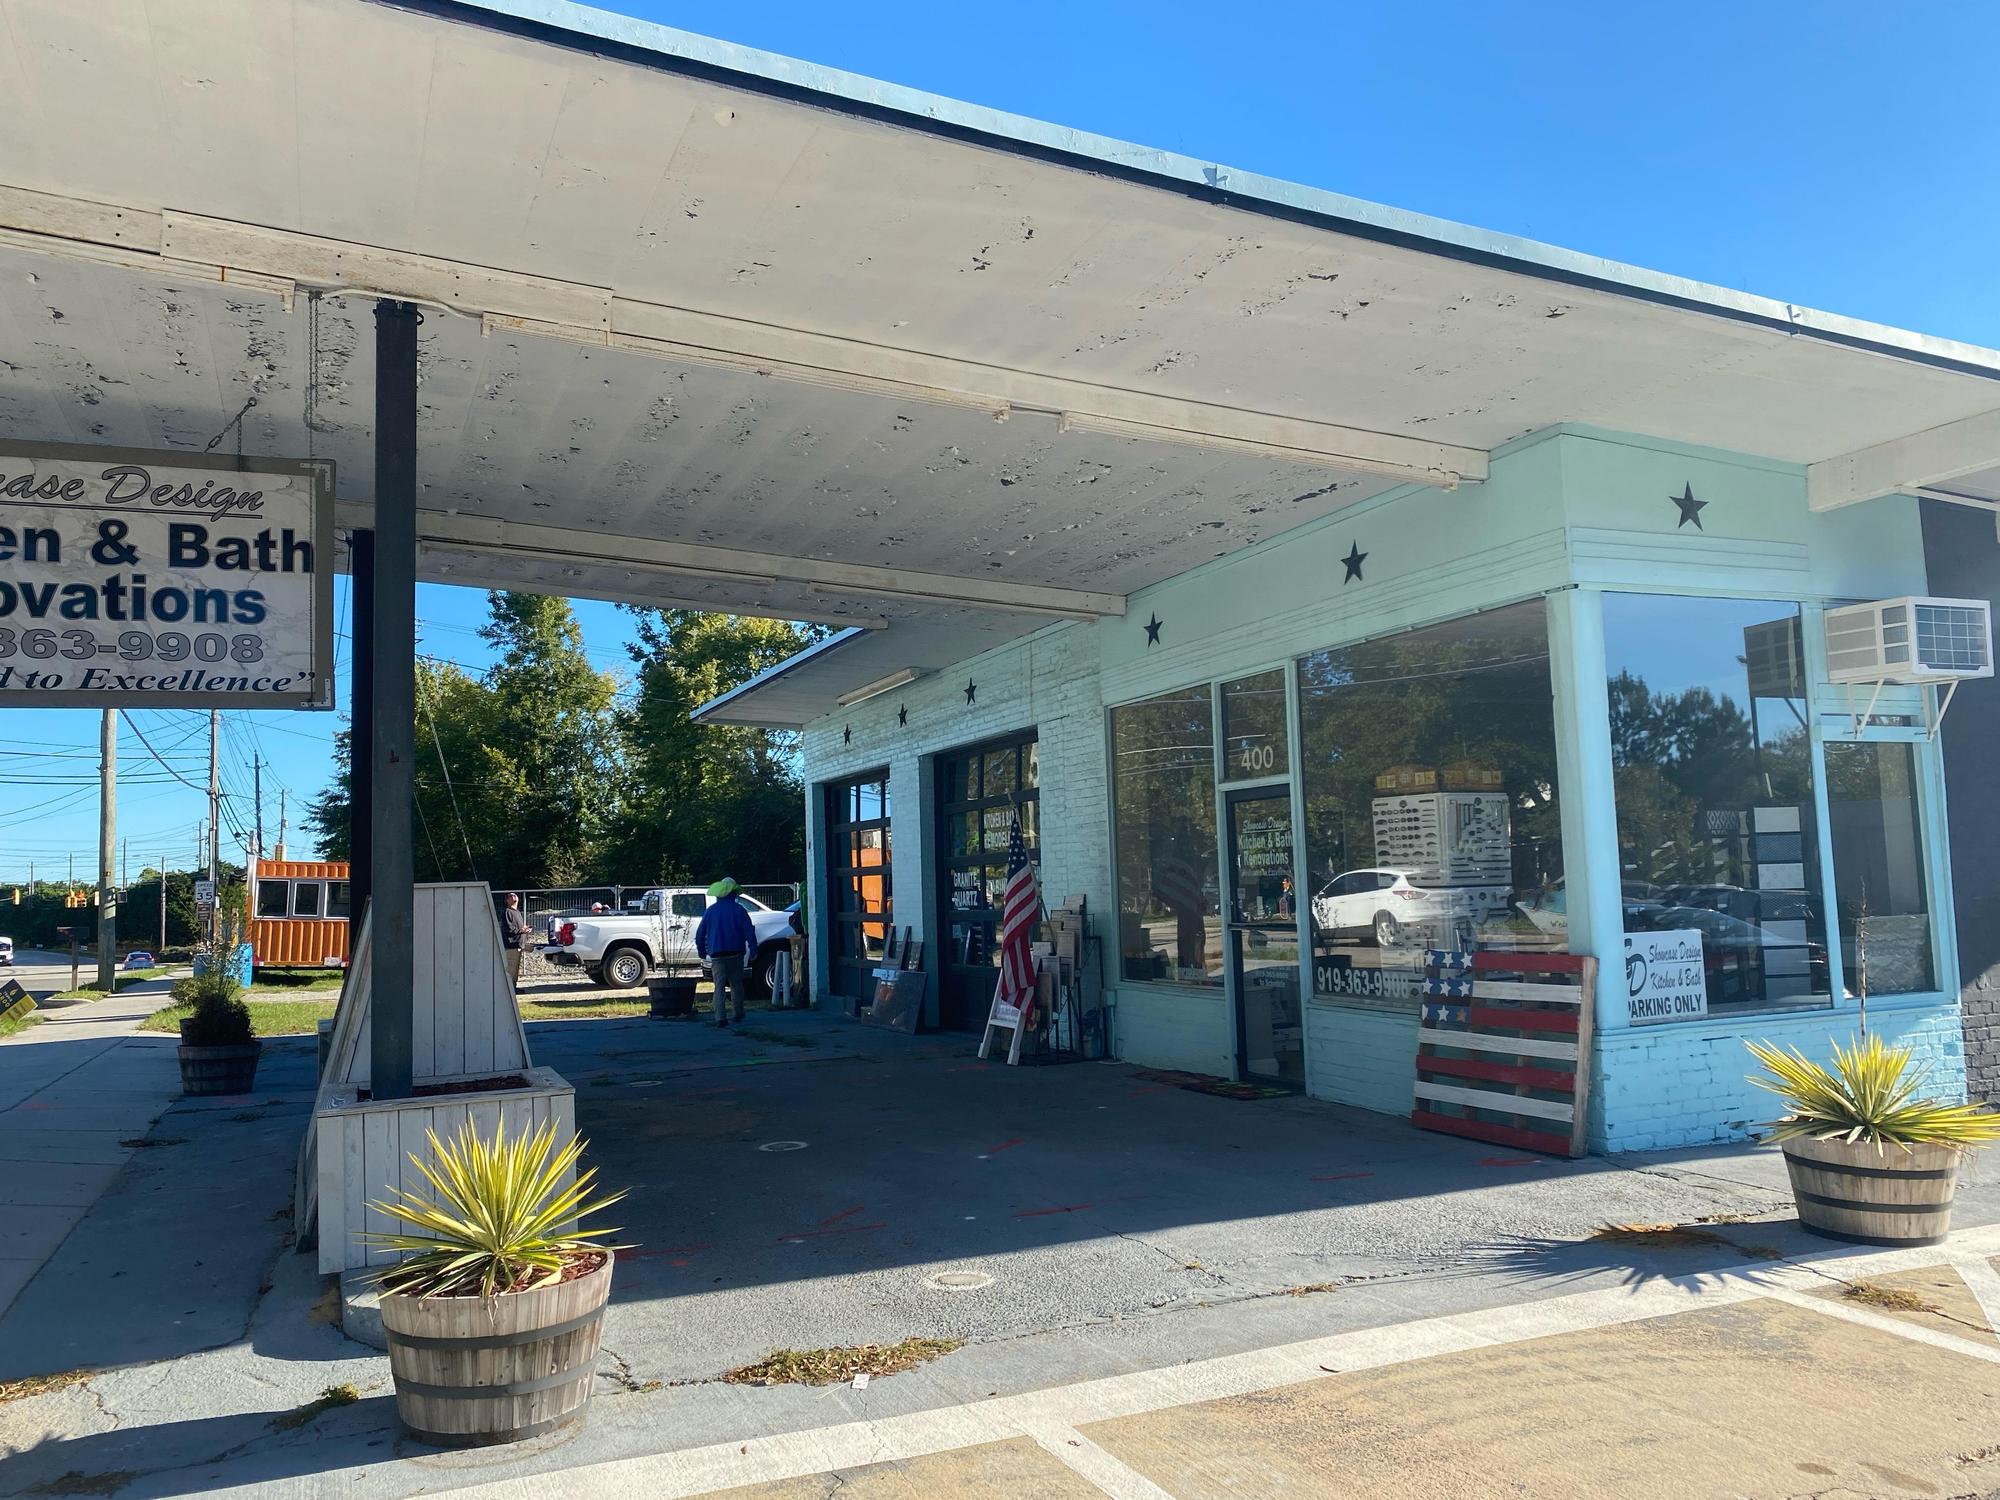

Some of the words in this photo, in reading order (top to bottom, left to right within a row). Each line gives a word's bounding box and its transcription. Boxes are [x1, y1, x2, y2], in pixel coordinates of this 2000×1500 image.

[102, 466, 264, 522] Design
[91, 519, 140, 565] &
[168, 522, 315, 573] Bath
[25, 670, 63, 690] to
[1241, 745, 1274, 770] 400
[1240, 830, 1267, 849] Kitchen
[1244, 848, 1289, 866] Renovations
[954, 872, 977, 887] GRANITE
[197, 892, 213, 900] 35
[954, 891, 978, 907] QUARTZ
[1649, 943, 1678, 963] Showcase
[1679, 941, 1702, 965] Design
[1317, 966, 1410, 998] 919-363-9908
[1650, 970, 1676, 990] Kitchen
[1685, 967, 1702, 987] Bath
[1674, 994, 1702, 1014] ONLY
